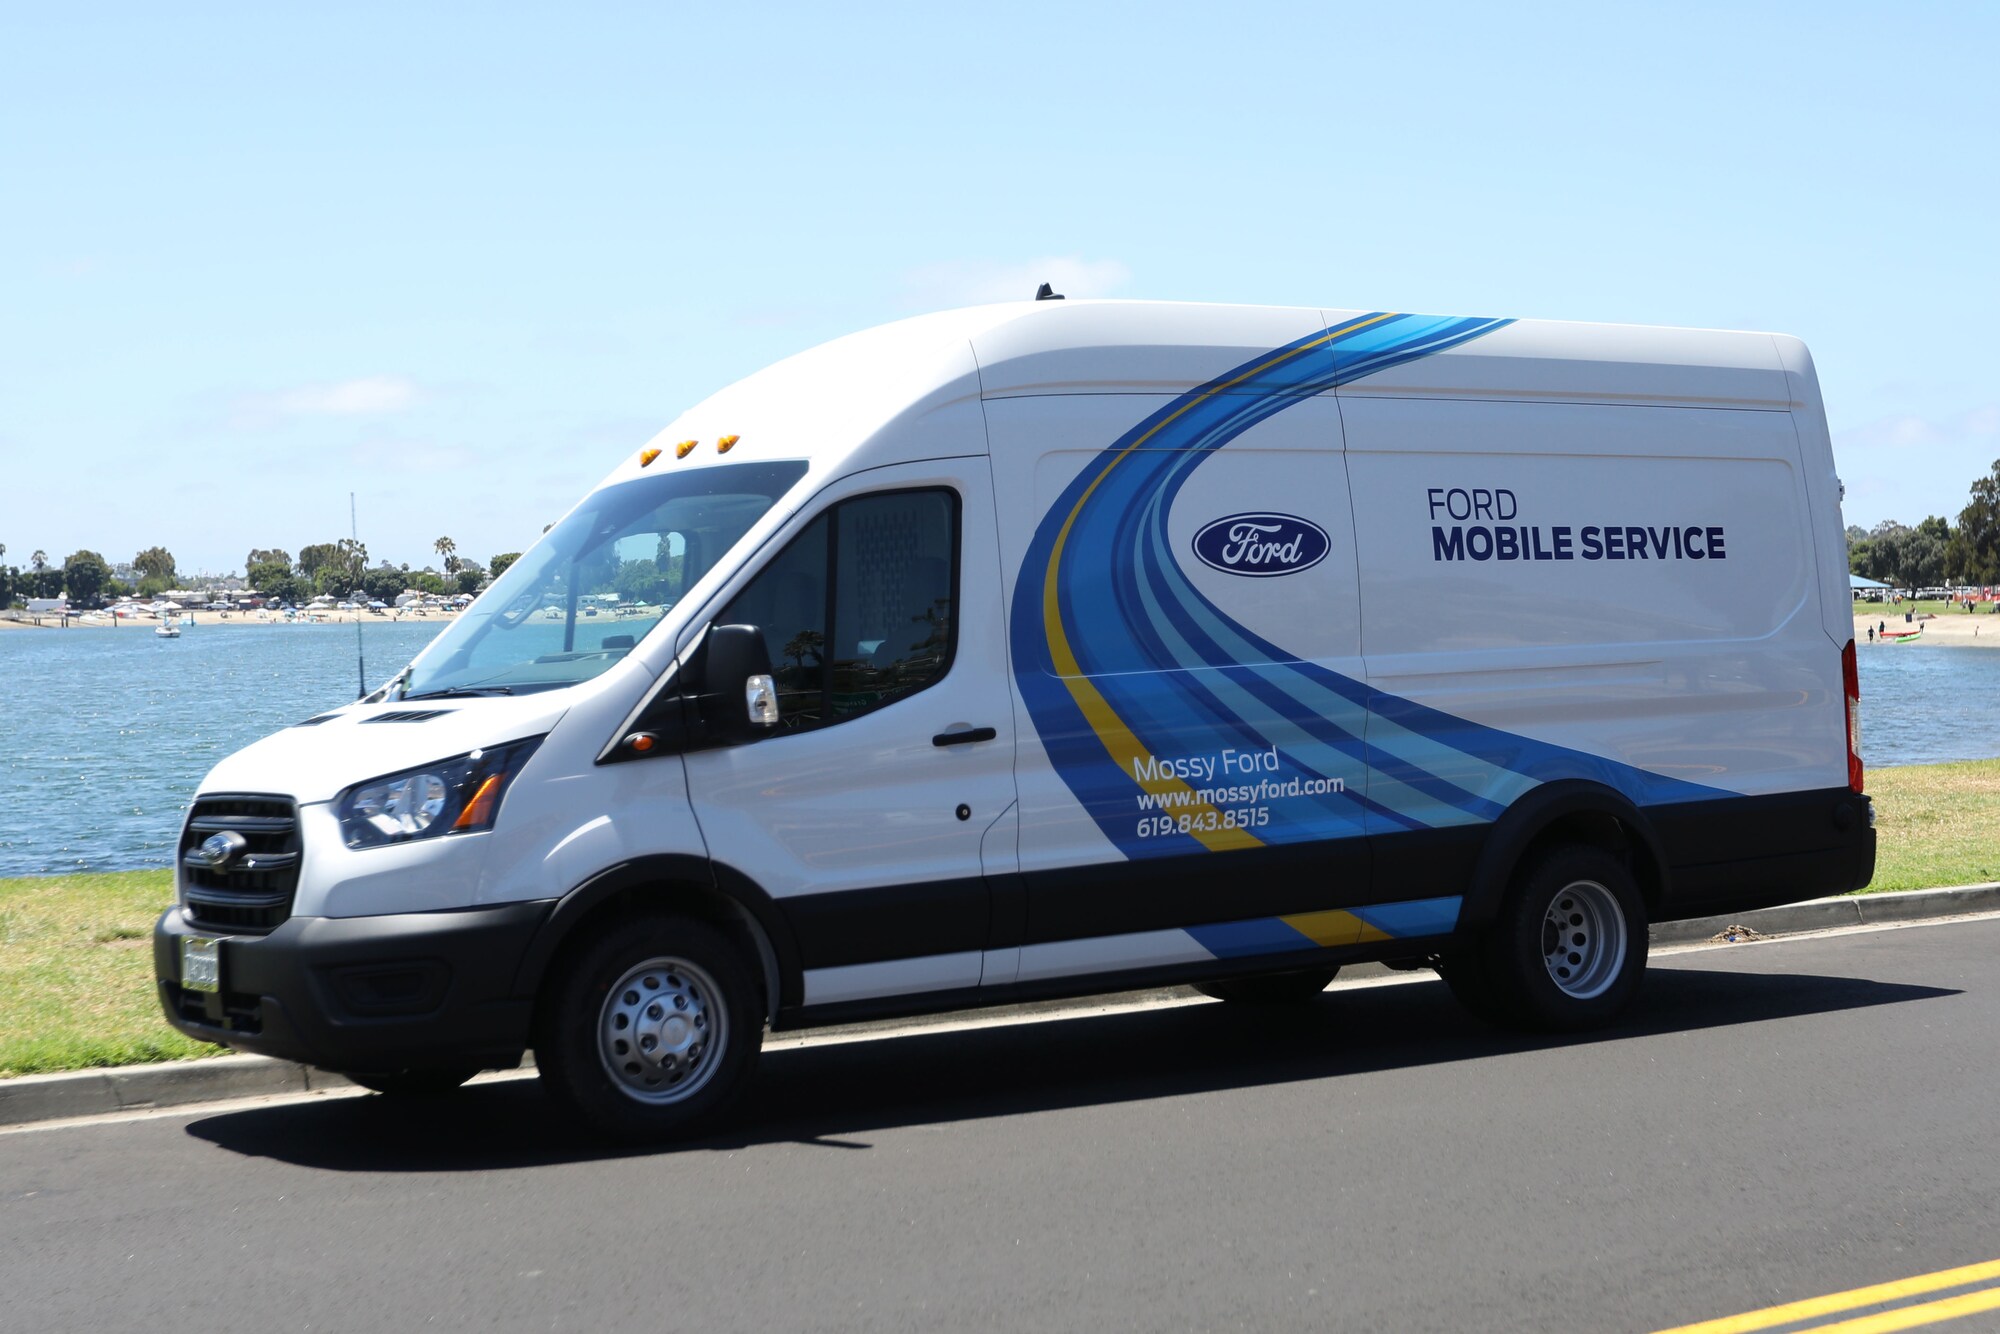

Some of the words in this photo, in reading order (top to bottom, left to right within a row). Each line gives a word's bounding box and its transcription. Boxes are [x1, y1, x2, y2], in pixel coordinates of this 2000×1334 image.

[1427, 488, 1517, 520] FORD
[1222, 523, 1303, 564] Ford
[1431, 526, 1574, 561] MOBILE
[1580, 526, 1726, 560] SERVICE
[1133, 755, 1215, 782] Mossy
[1222, 745, 1279, 774] Ford
[1137, 777, 1344, 810] www.mossyford.com
[1137, 807, 1269, 838] 619.843.8515
